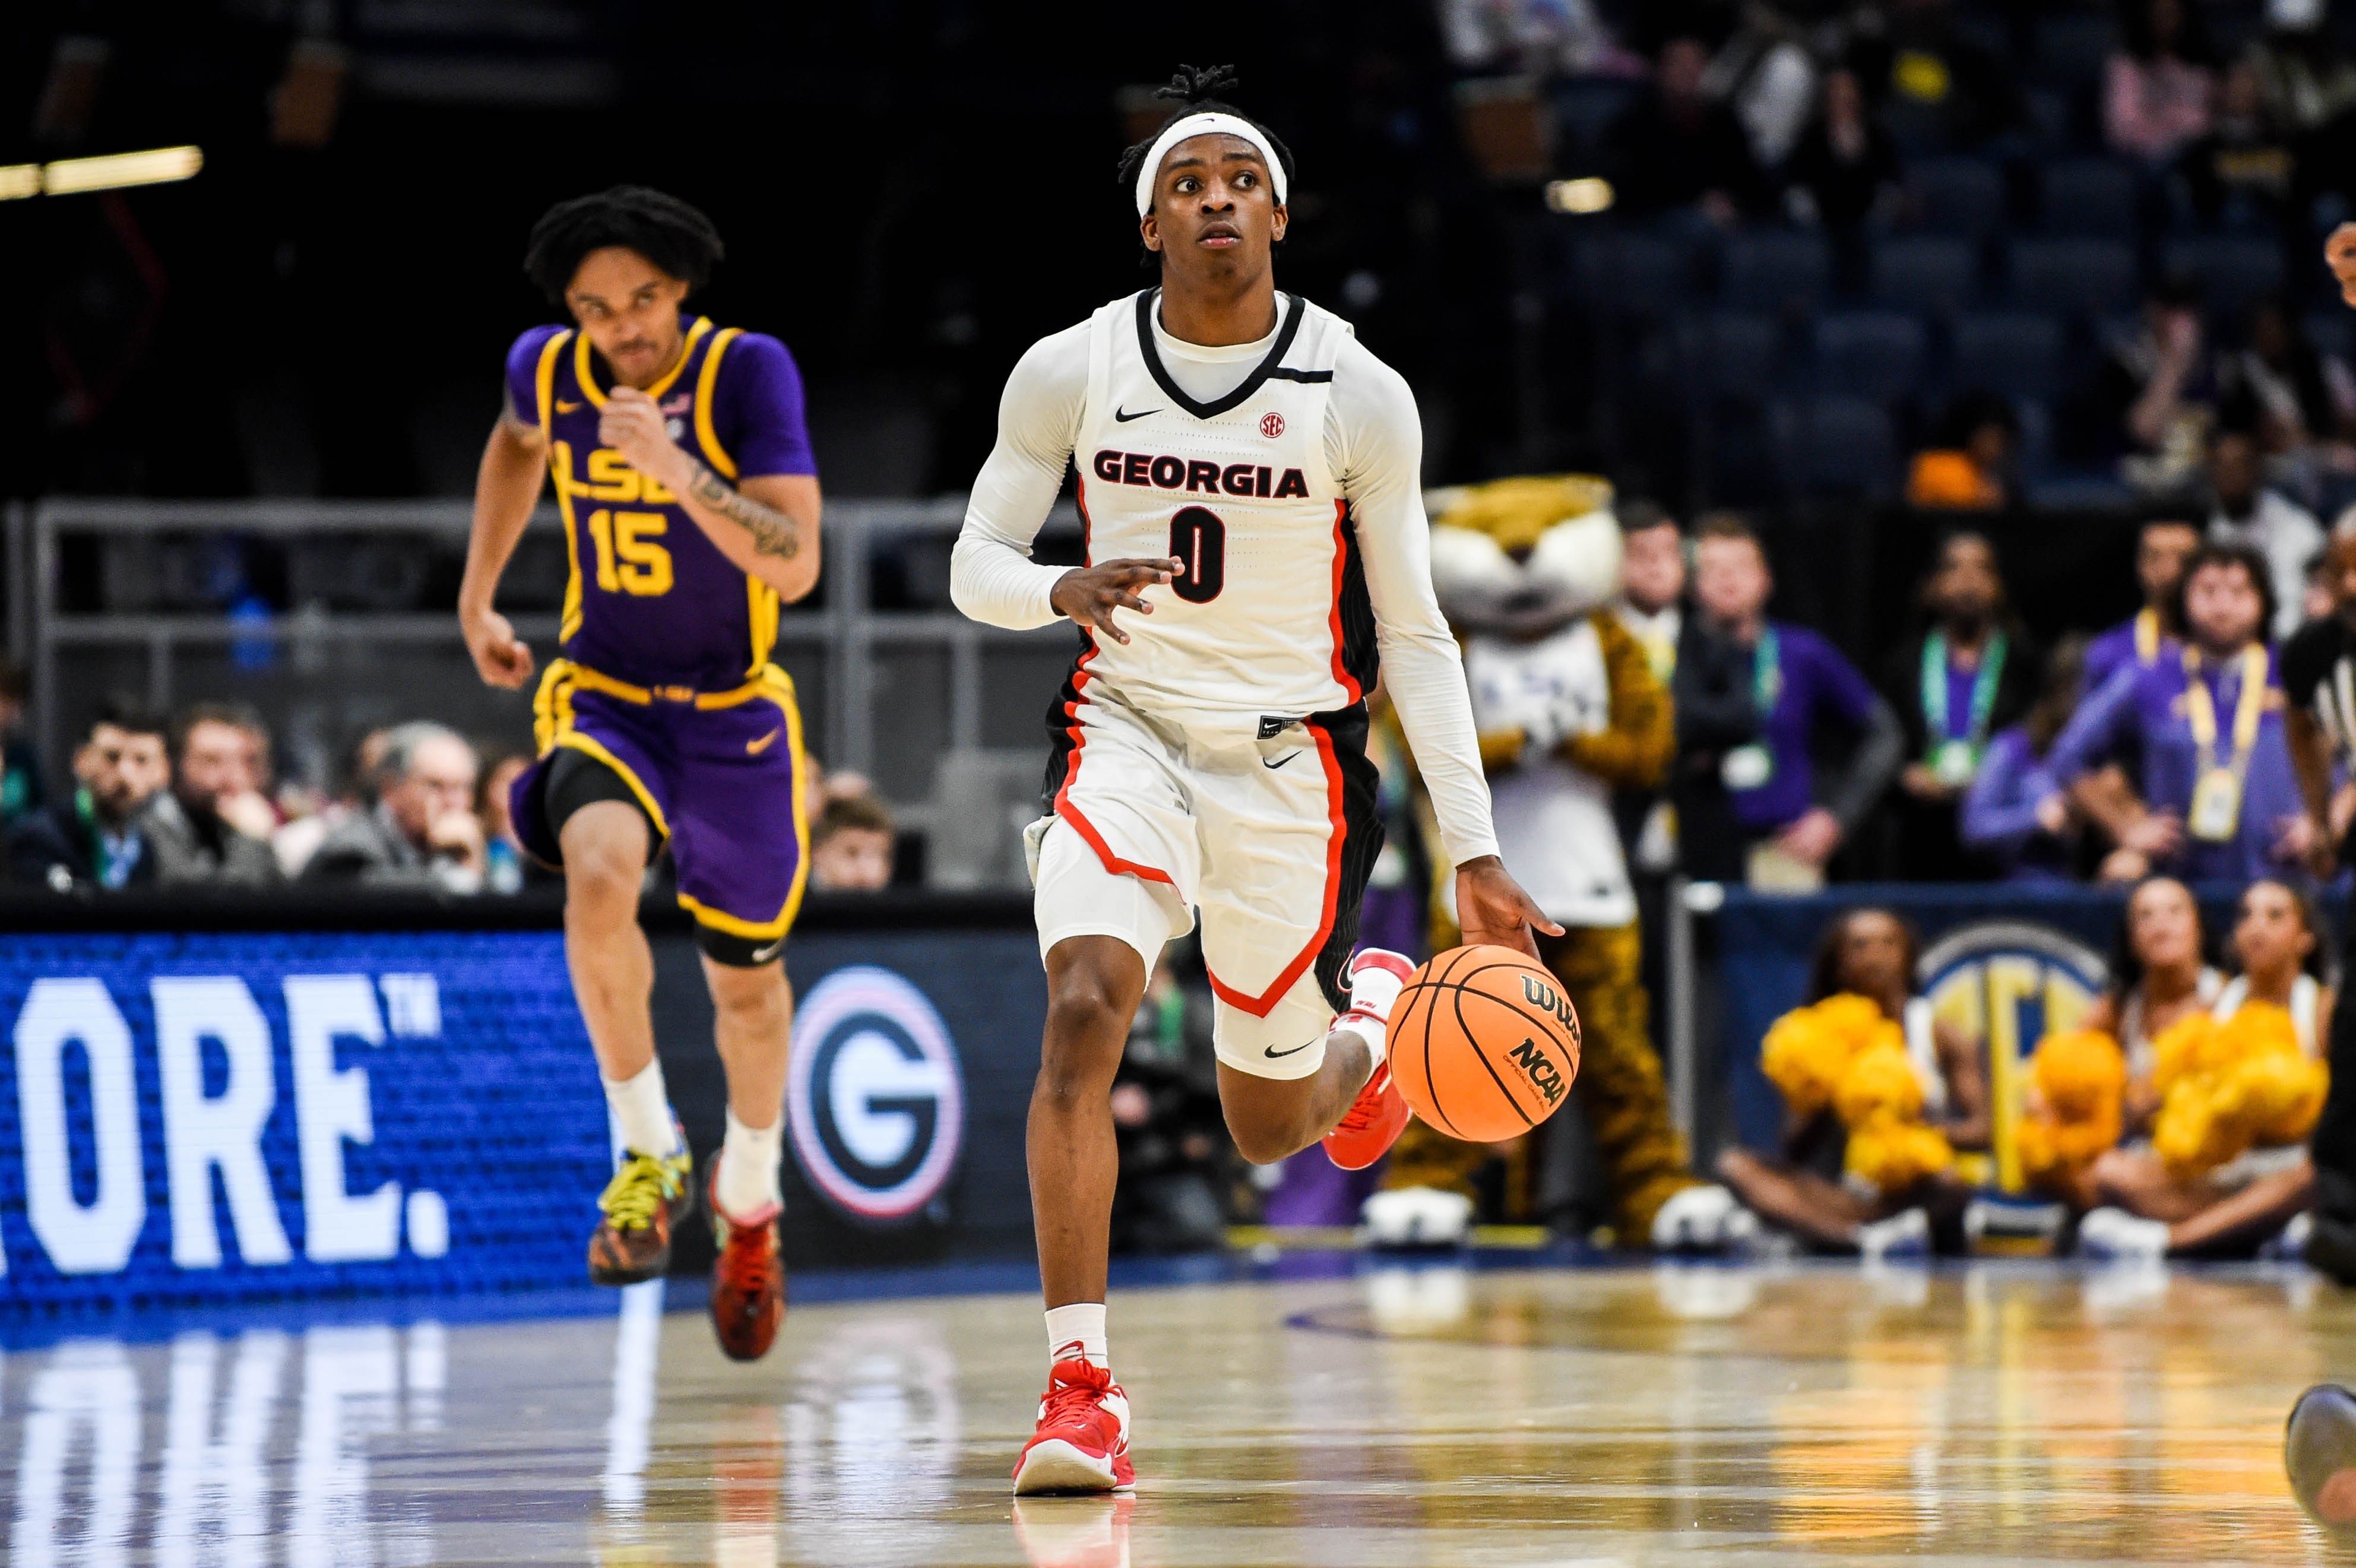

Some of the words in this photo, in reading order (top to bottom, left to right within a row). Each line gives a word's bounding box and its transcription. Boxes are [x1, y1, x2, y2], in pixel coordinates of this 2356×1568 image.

[1262, 414, 1282, 436] SEC
[1094, 449, 1310, 499] GEORGIA
[588, 508, 674, 597] 15
[1169, 506, 1226, 604] 0
[1503, 1054, 1527, 1085] OFFICIAL
[1509, 1037, 1566, 1108] NCAA
